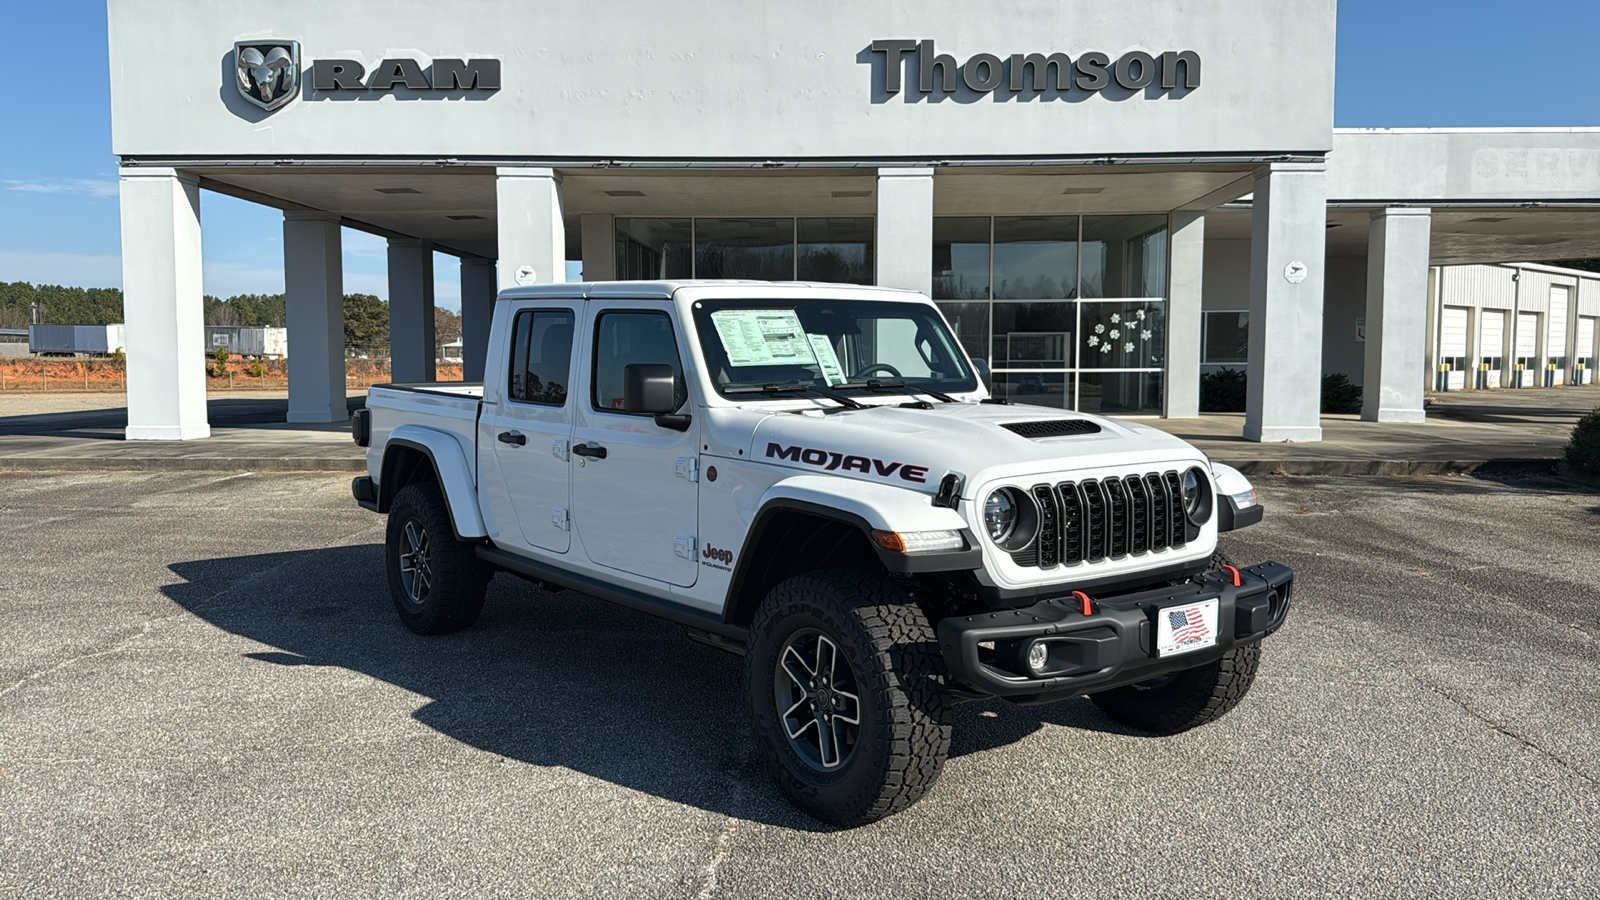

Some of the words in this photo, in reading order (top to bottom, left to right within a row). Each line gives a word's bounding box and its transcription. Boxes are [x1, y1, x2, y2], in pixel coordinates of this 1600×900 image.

[313, 58, 501, 90] RAM
[872, 39, 1201, 92] Thomson
[766, 442, 929, 483] MOJAVE
[702, 542, 733, 566] Jeep
